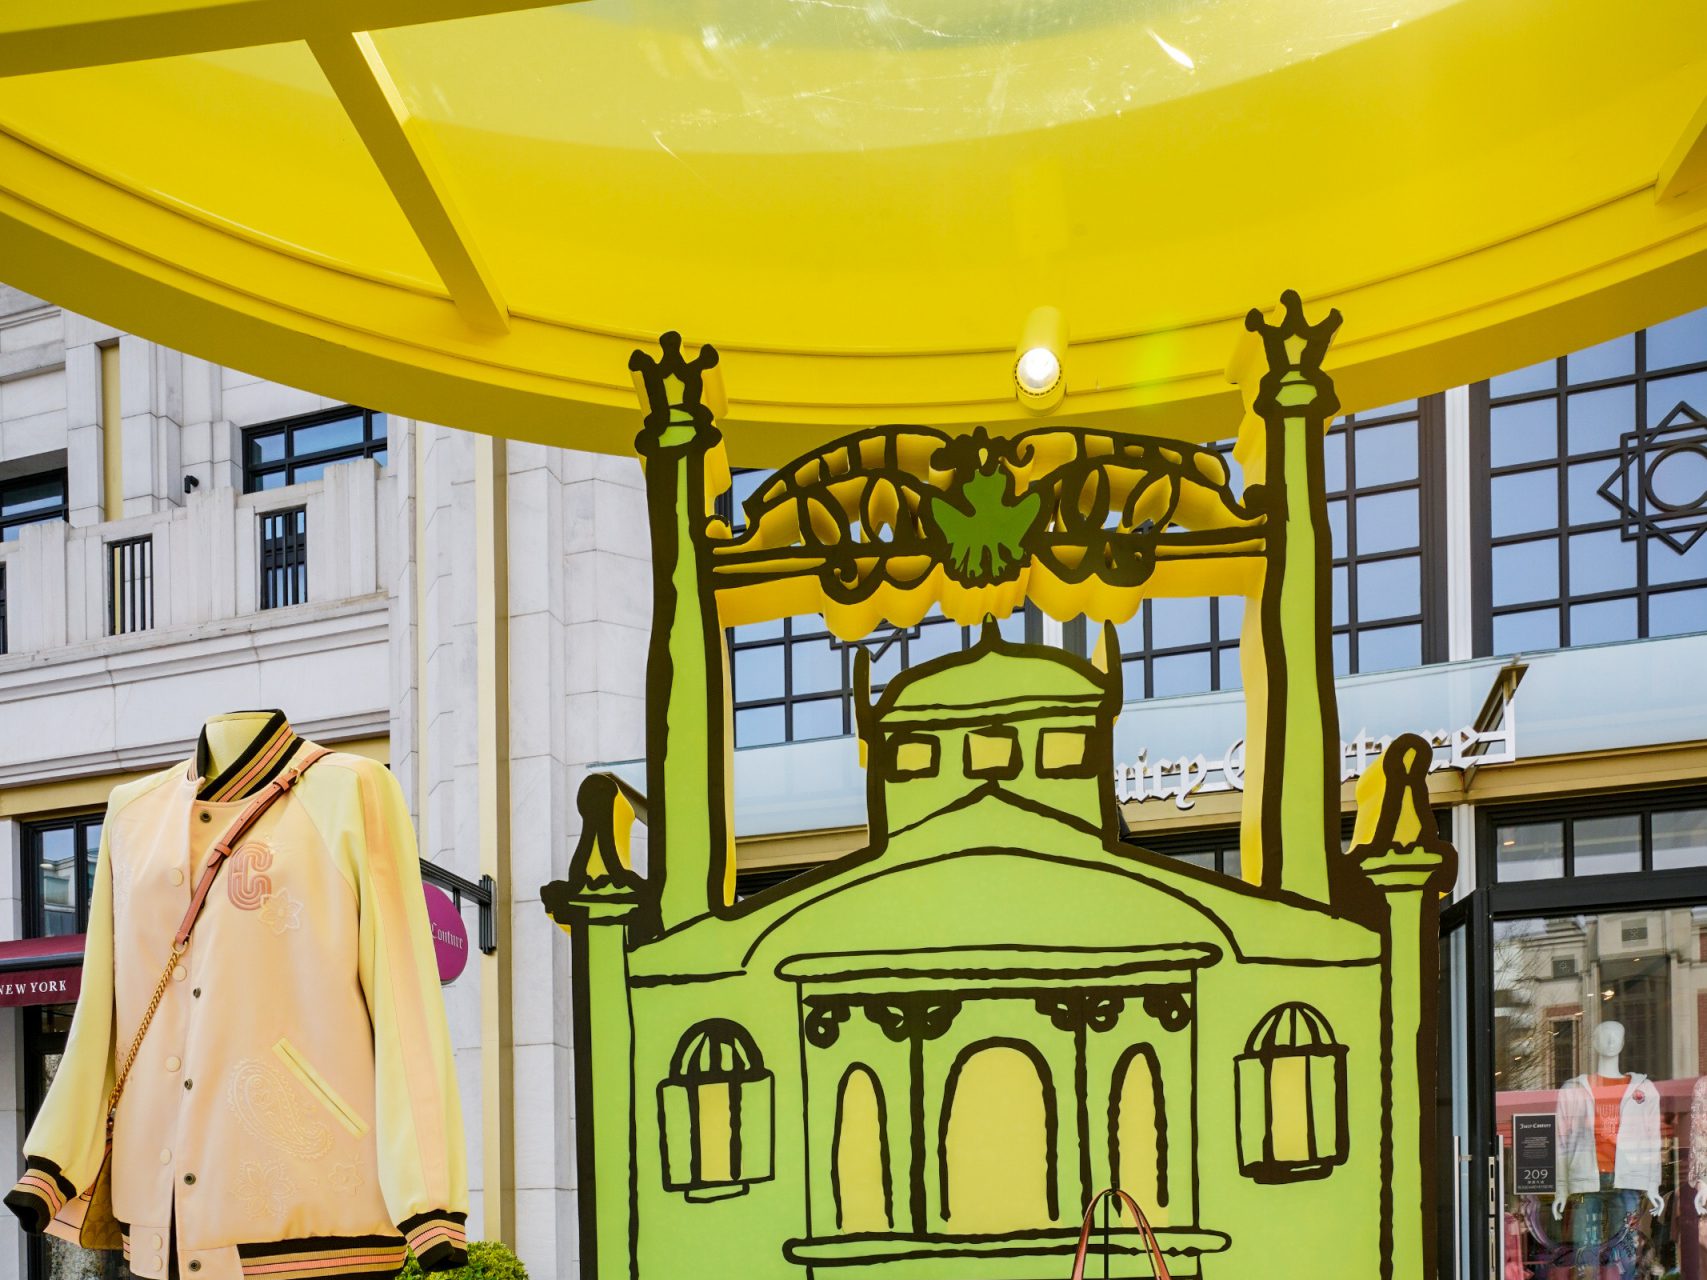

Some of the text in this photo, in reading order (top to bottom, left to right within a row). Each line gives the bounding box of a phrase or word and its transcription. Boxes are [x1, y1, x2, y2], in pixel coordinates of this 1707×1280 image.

[431, 922, 463, 950] Couture
[30, 980, 67, 993] YORK
[1524, 1169, 1548, 1180] 209
